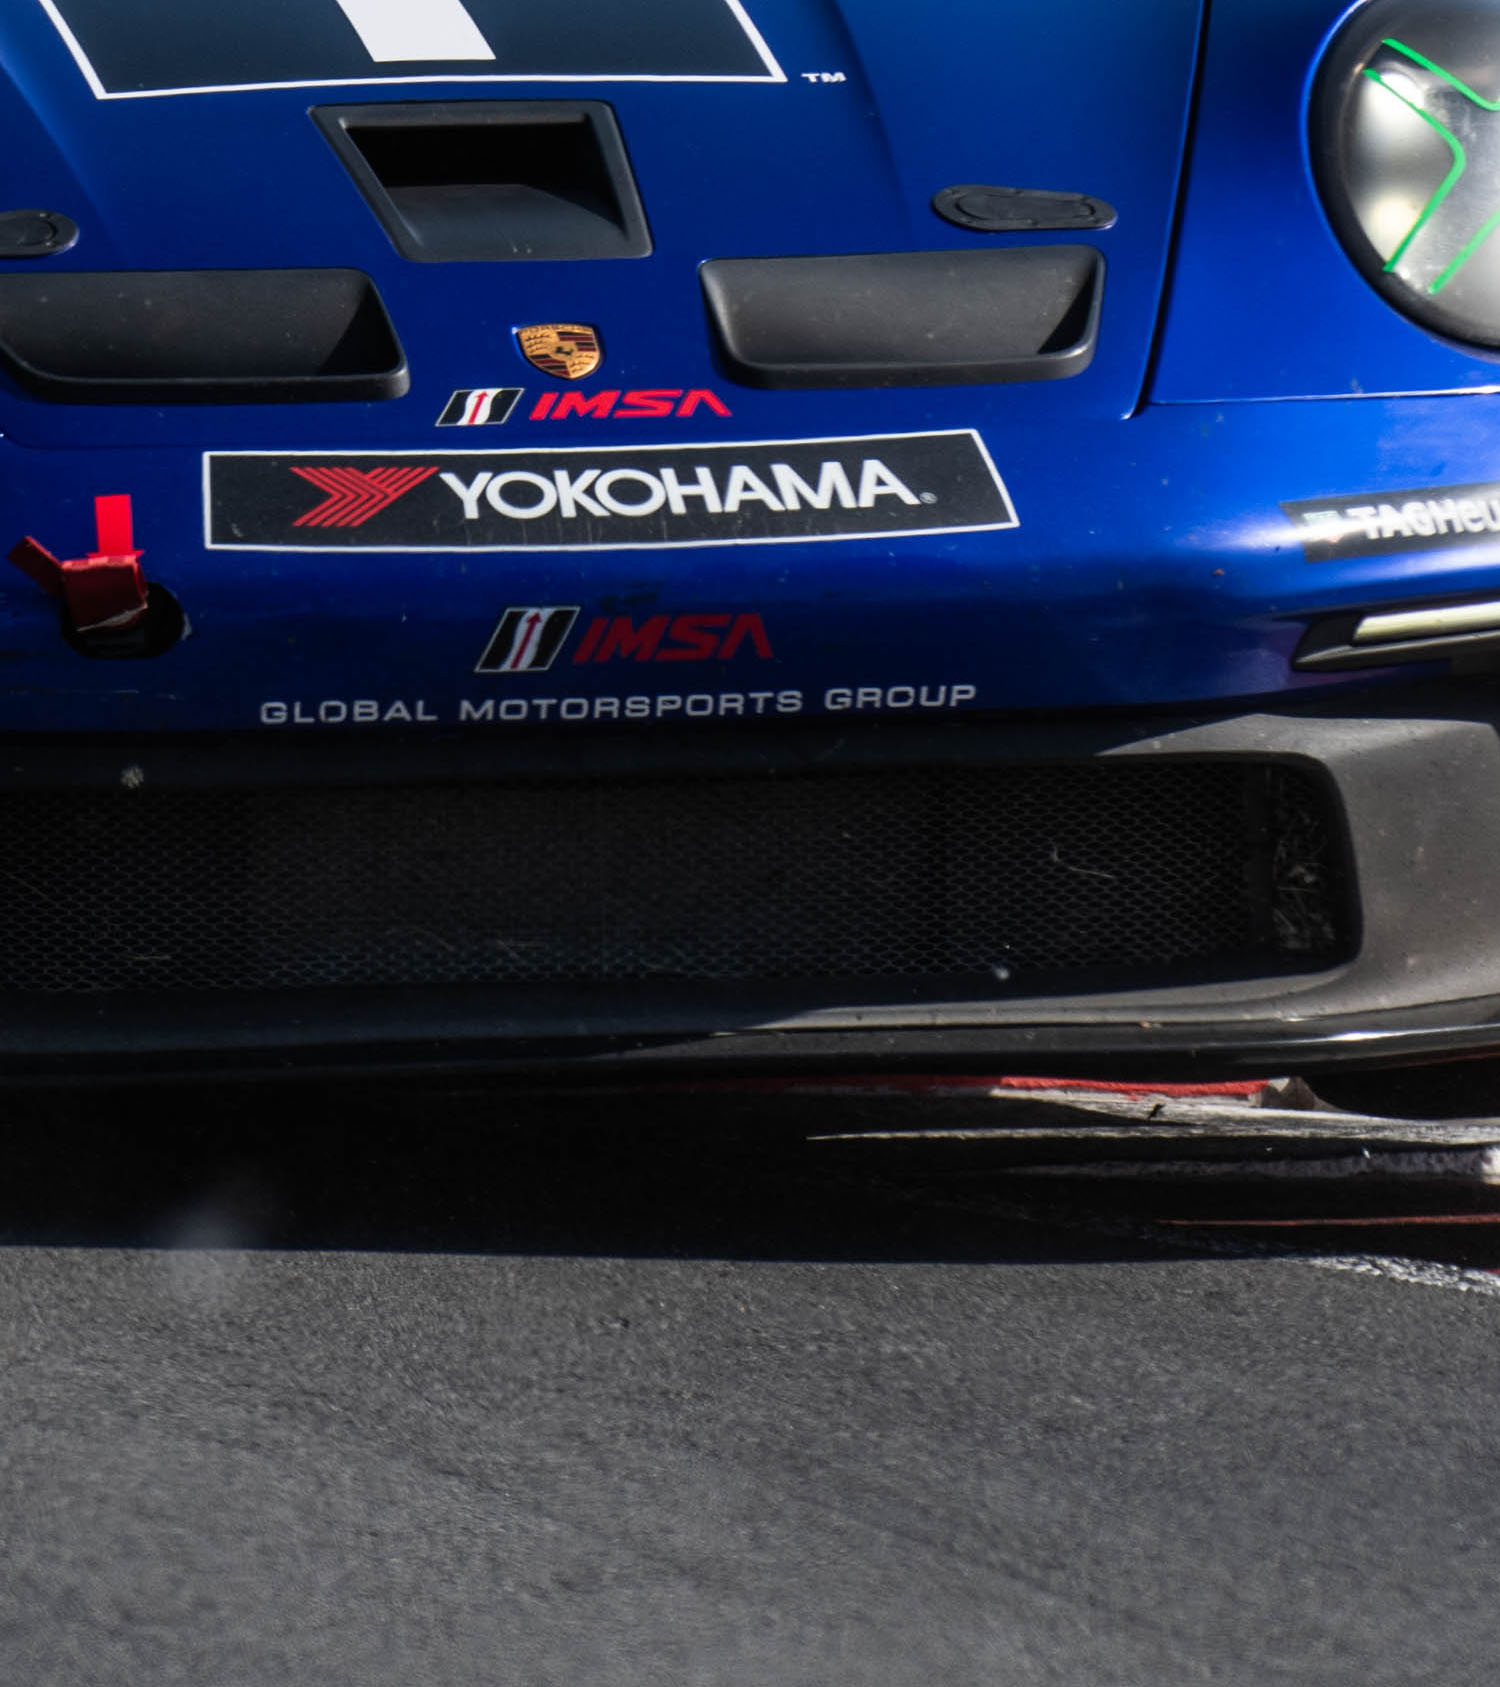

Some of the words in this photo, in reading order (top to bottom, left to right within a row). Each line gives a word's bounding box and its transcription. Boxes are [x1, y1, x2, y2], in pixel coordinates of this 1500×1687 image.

[528, 388, 733, 419] IMSA
[438, 459, 922, 520] YOKOHAMA
[573, 613, 775, 664] IMSA
[261, 700, 437, 725] GLOBAL
[459, 691, 803, 722] MOTORSPORTS
[825, 684, 977, 710] GROUP
